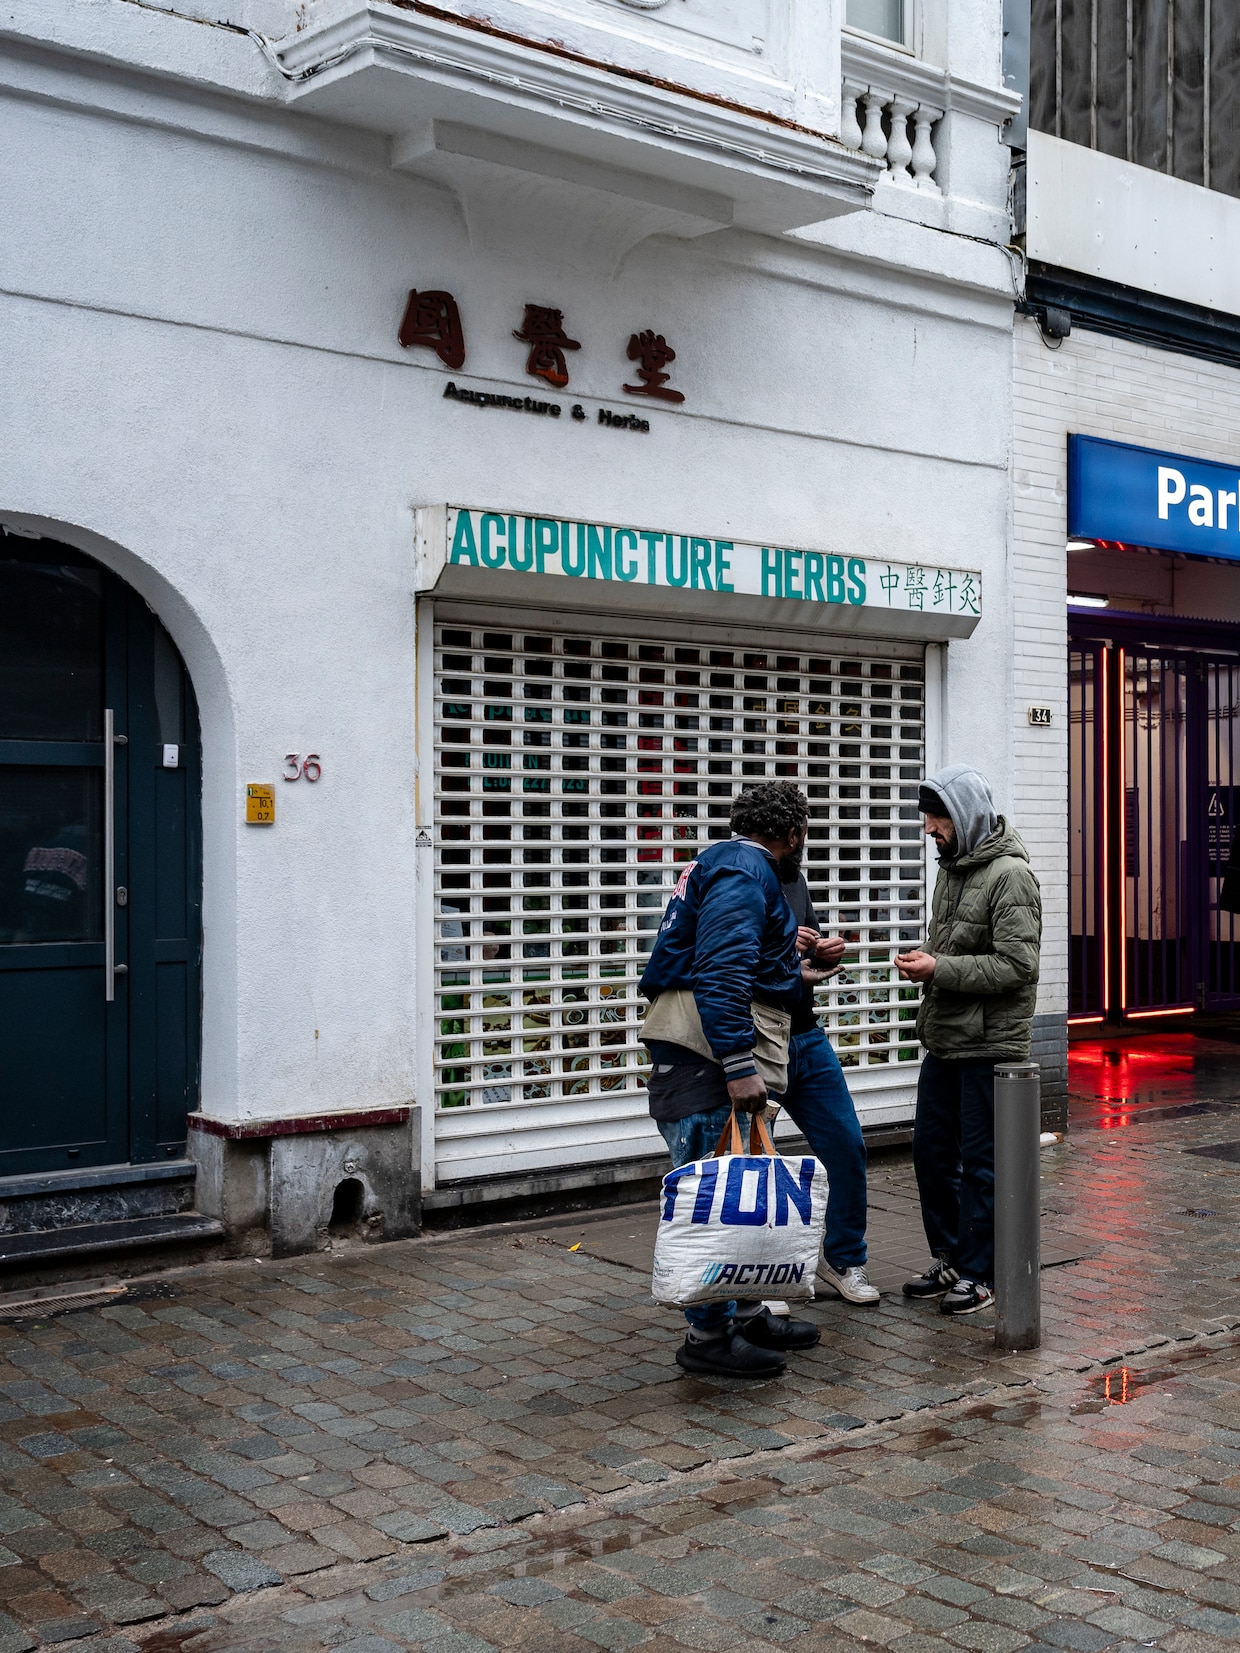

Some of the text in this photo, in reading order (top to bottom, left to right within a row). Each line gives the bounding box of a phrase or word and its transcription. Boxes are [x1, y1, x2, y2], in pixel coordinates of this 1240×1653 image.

[443, 381, 651, 433] Acupuncture & Herbs
[450, 509, 866, 606] ACUPUNCTURE HERBS
[879, 564, 981, 615] 中醫針灸
[1035, 709, 1048, 722] 34
[283, 753, 321, 782] 36
[714, 1263, 805, 1285] ACTION
